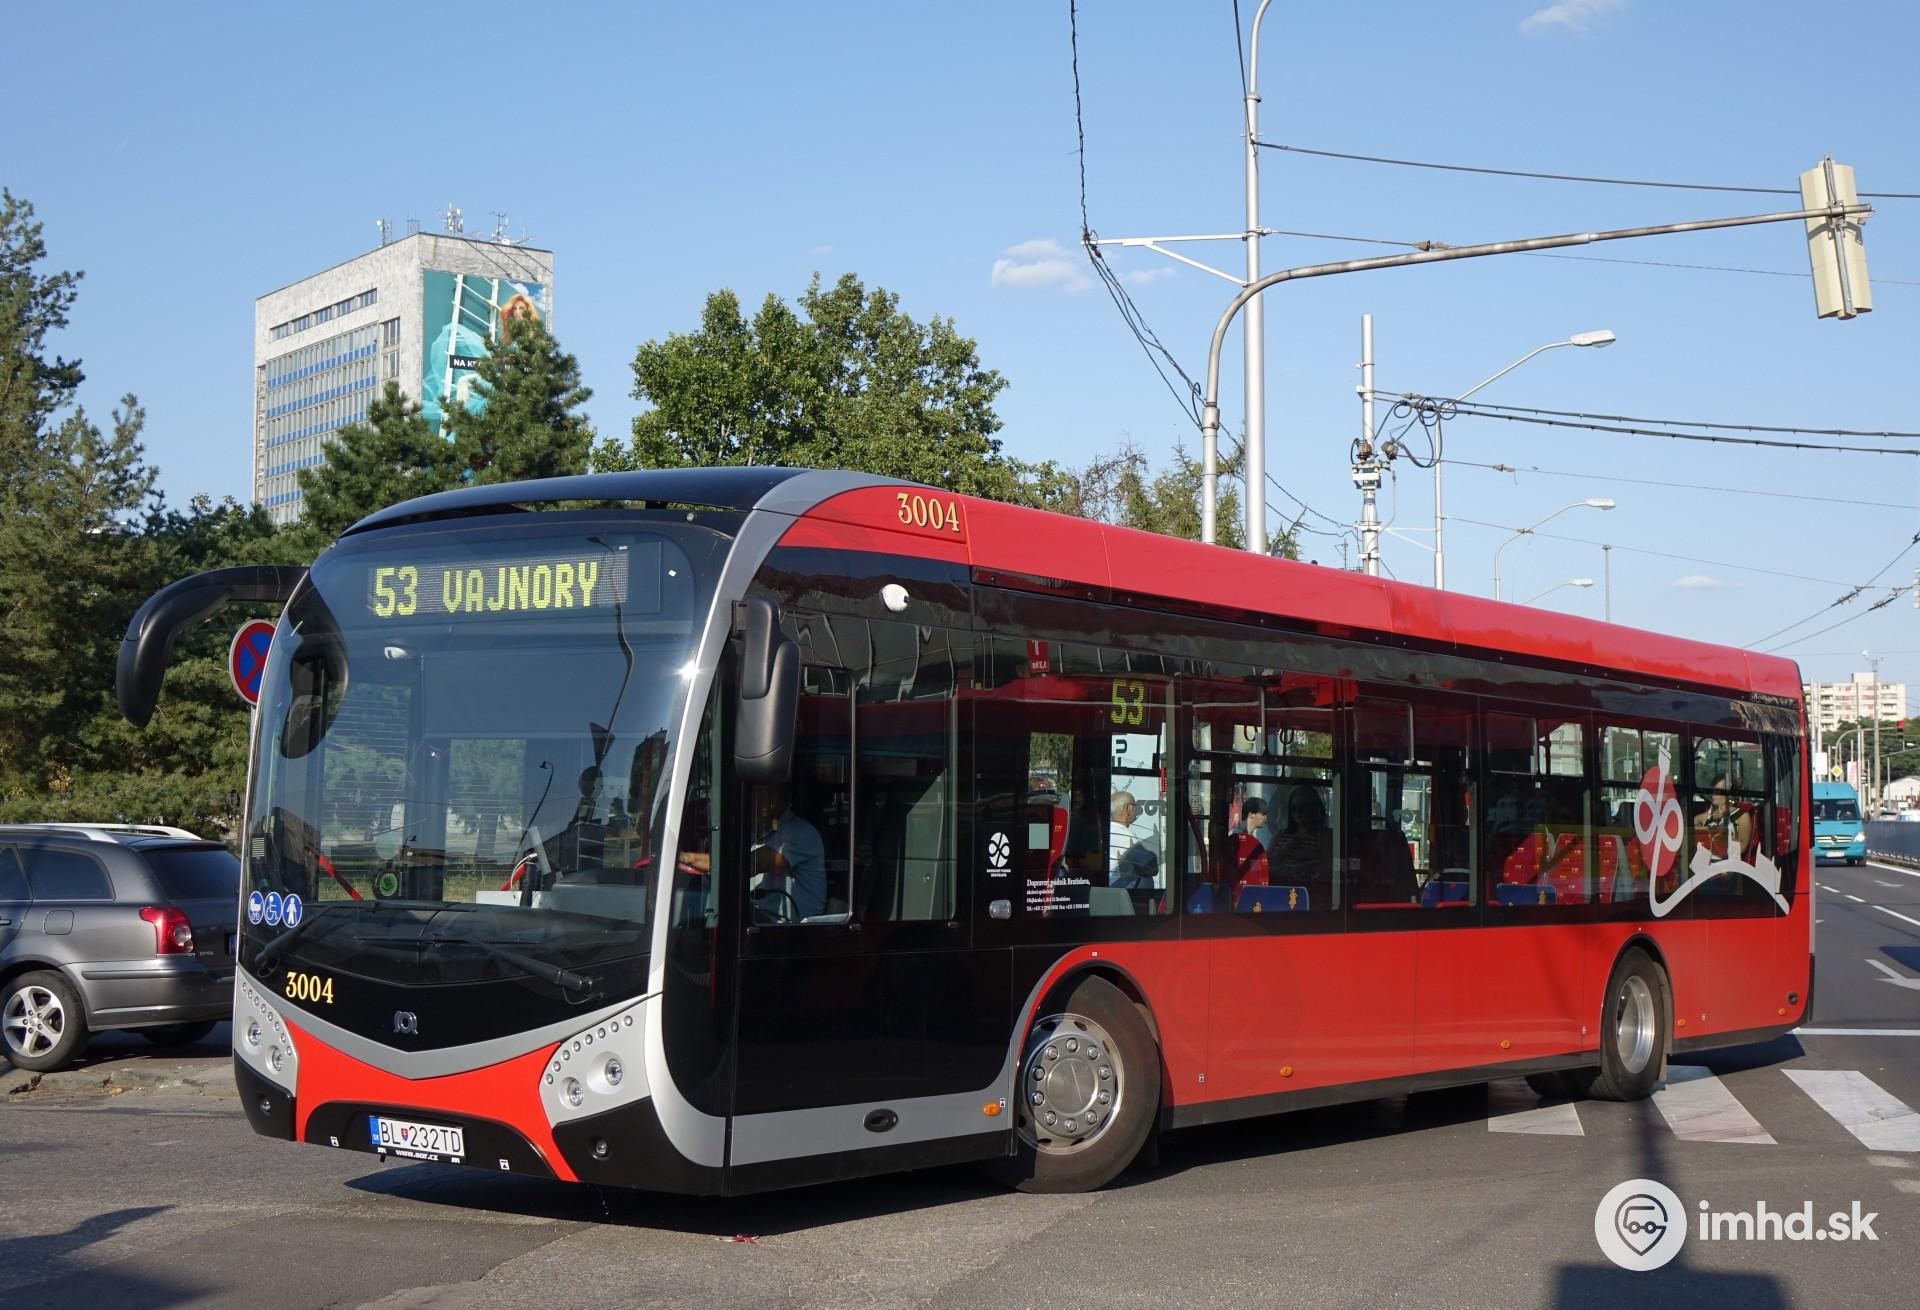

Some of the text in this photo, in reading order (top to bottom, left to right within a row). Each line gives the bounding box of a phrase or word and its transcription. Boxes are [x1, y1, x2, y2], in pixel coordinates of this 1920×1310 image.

[453, 358, 466, 367] NA
[897, 492, 960, 532] 3004
[374, 561, 598, 617] 53 VAJNORY
[1110, 678, 1145, 725] 53
[285, 971, 334, 1004] 3004
[380, 1121, 462, 1152] BL 232TD
